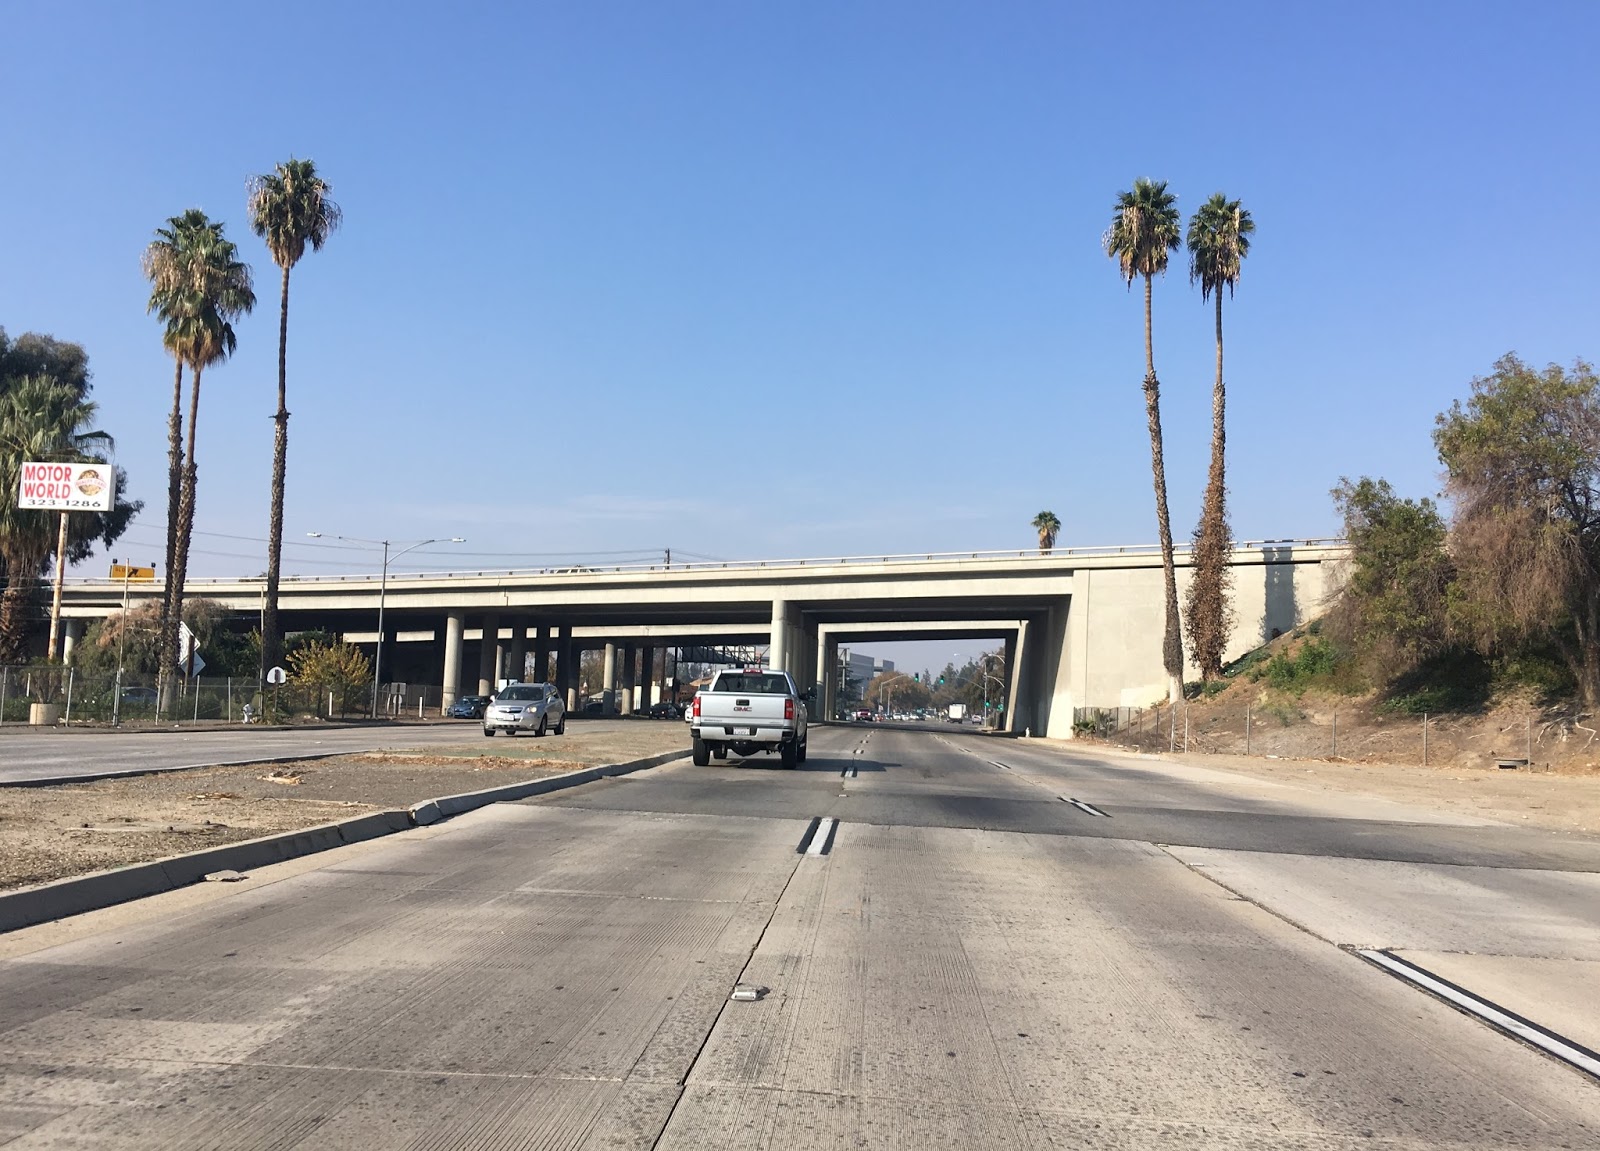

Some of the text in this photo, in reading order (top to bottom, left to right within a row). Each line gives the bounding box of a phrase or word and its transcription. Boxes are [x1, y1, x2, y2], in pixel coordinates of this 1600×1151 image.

[25, 465, 72, 482] MOTOR
[24, 483, 71, 499] WORLD
[28, 499, 101, 507] 323-1286
